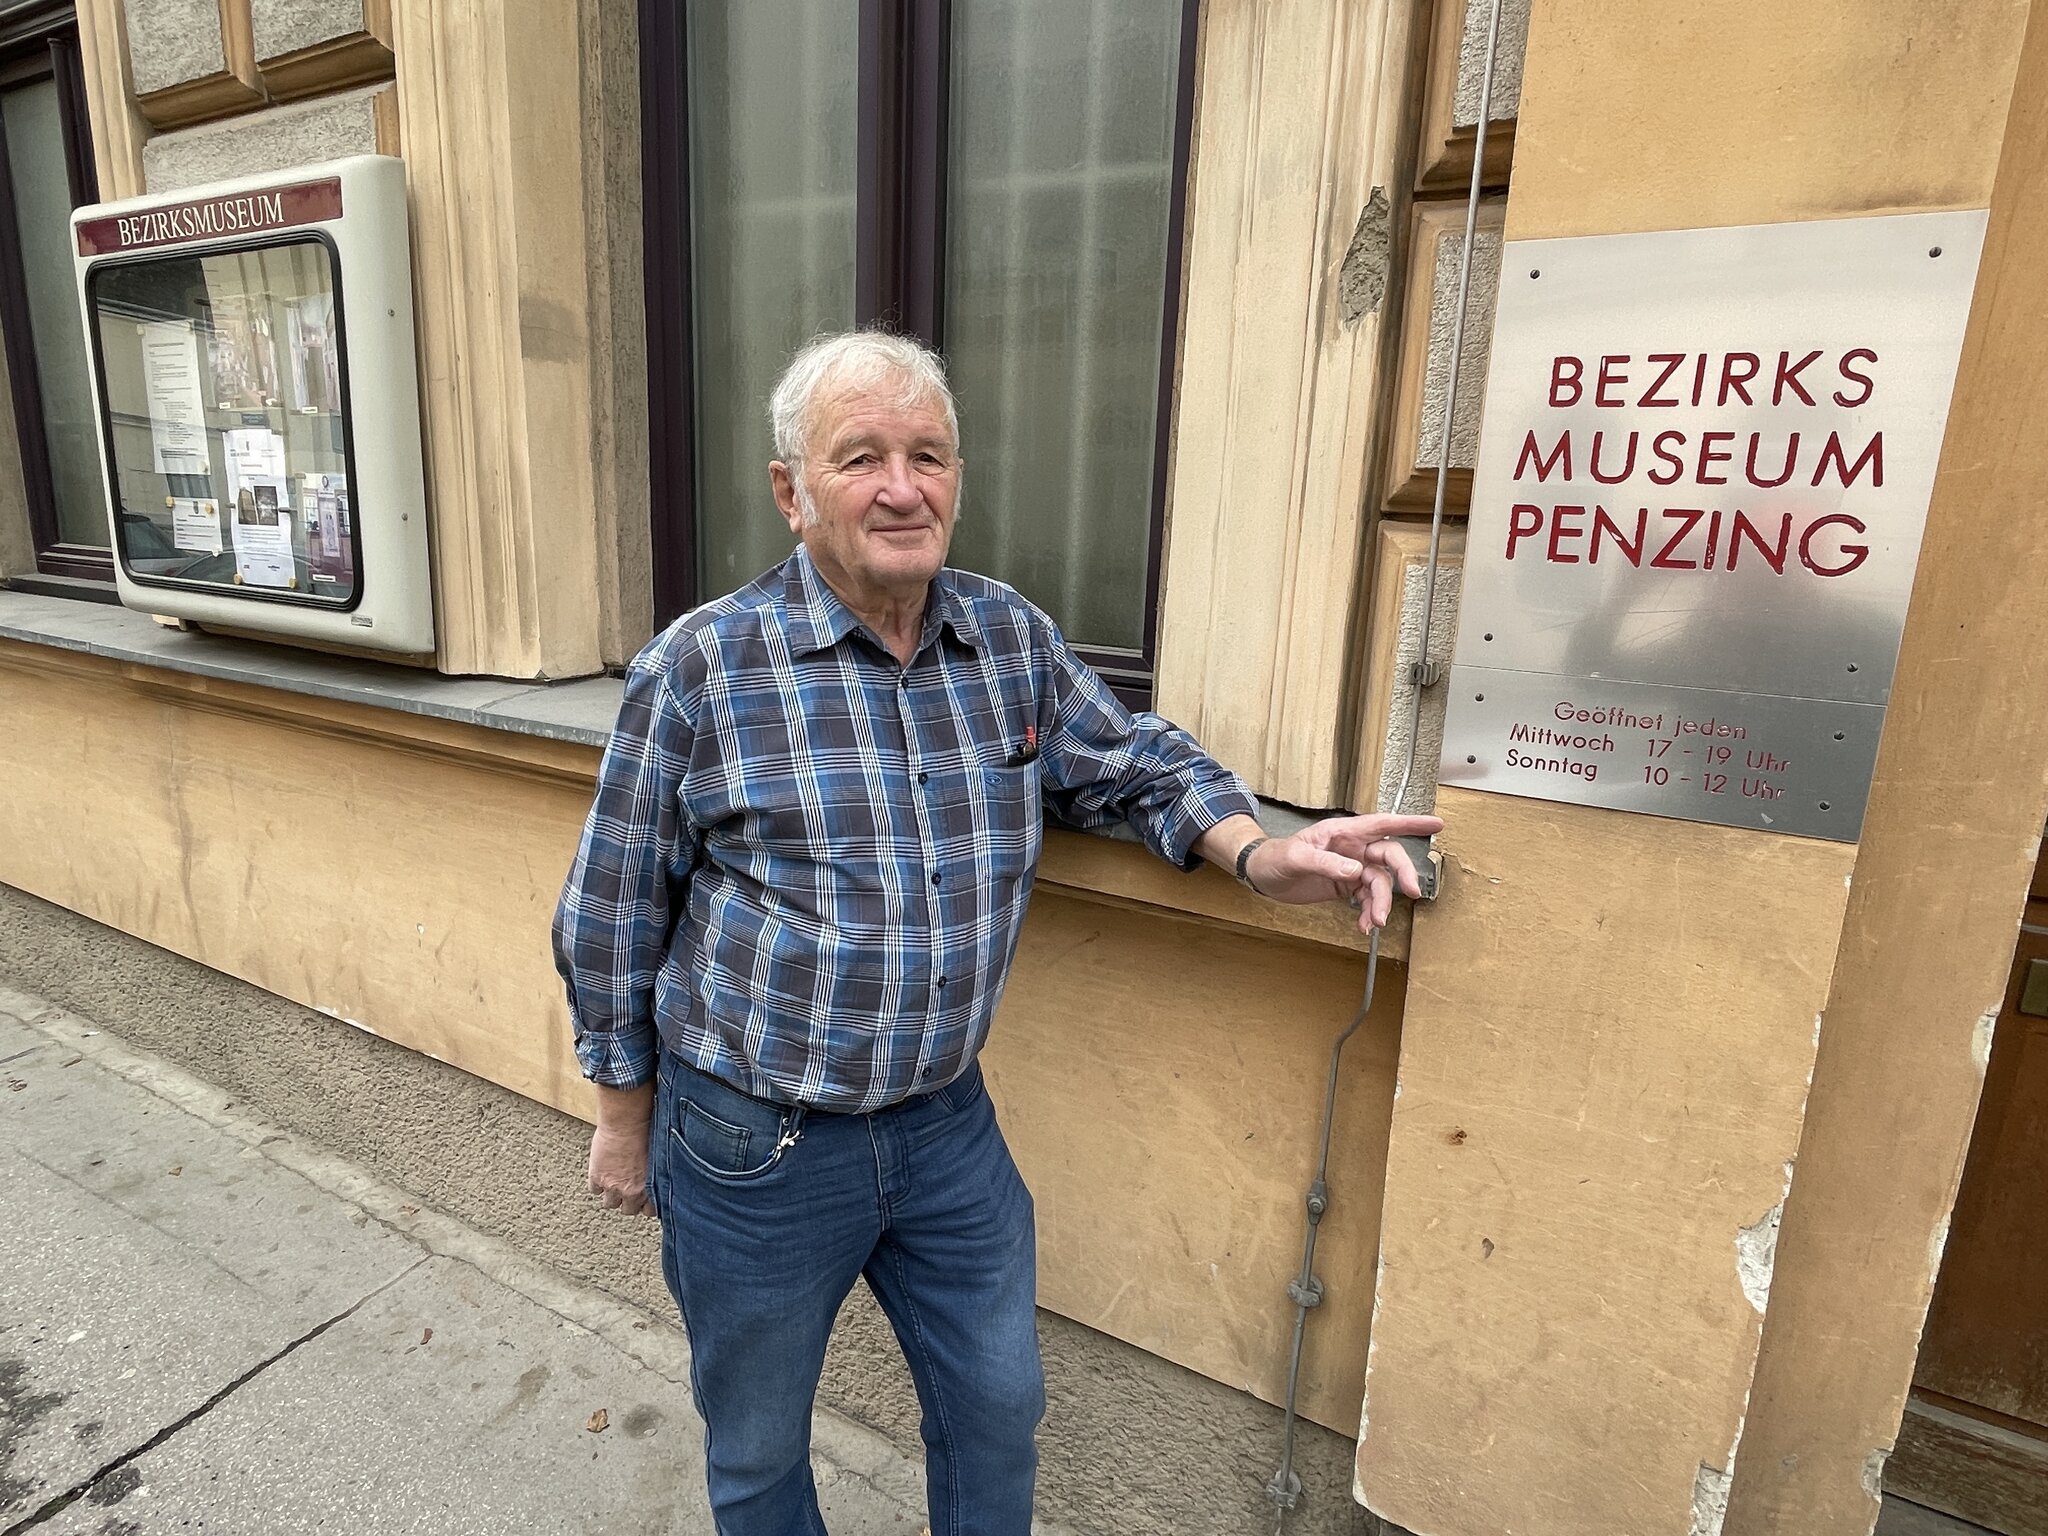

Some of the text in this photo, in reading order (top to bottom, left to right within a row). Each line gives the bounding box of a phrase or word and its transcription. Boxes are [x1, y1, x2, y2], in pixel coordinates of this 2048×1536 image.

[117, 193, 284, 246] BEZIRKSMUSEUM
[1548, 348, 1879, 409] BEZIRKS
[1512, 429, 1885, 489] MUSEUM
[1505, 503, 1870, 578] PENZING
[1554, 701, 1747, 740] Geöffnet jeden
[1506, 748, 1598, 782] Sonntag
[1643, 765, 1669, 786] 10
[1703, 773, 1728, 794] 12
[1741, 777, 1786, 801] Uhr
[1509, 723, 1615, 752] Mittwoch
[1647, 738, 1673, 759] 17
[1706, 745, 1732, 766] 19
[1746, 749, 1791, 773] Uhr
